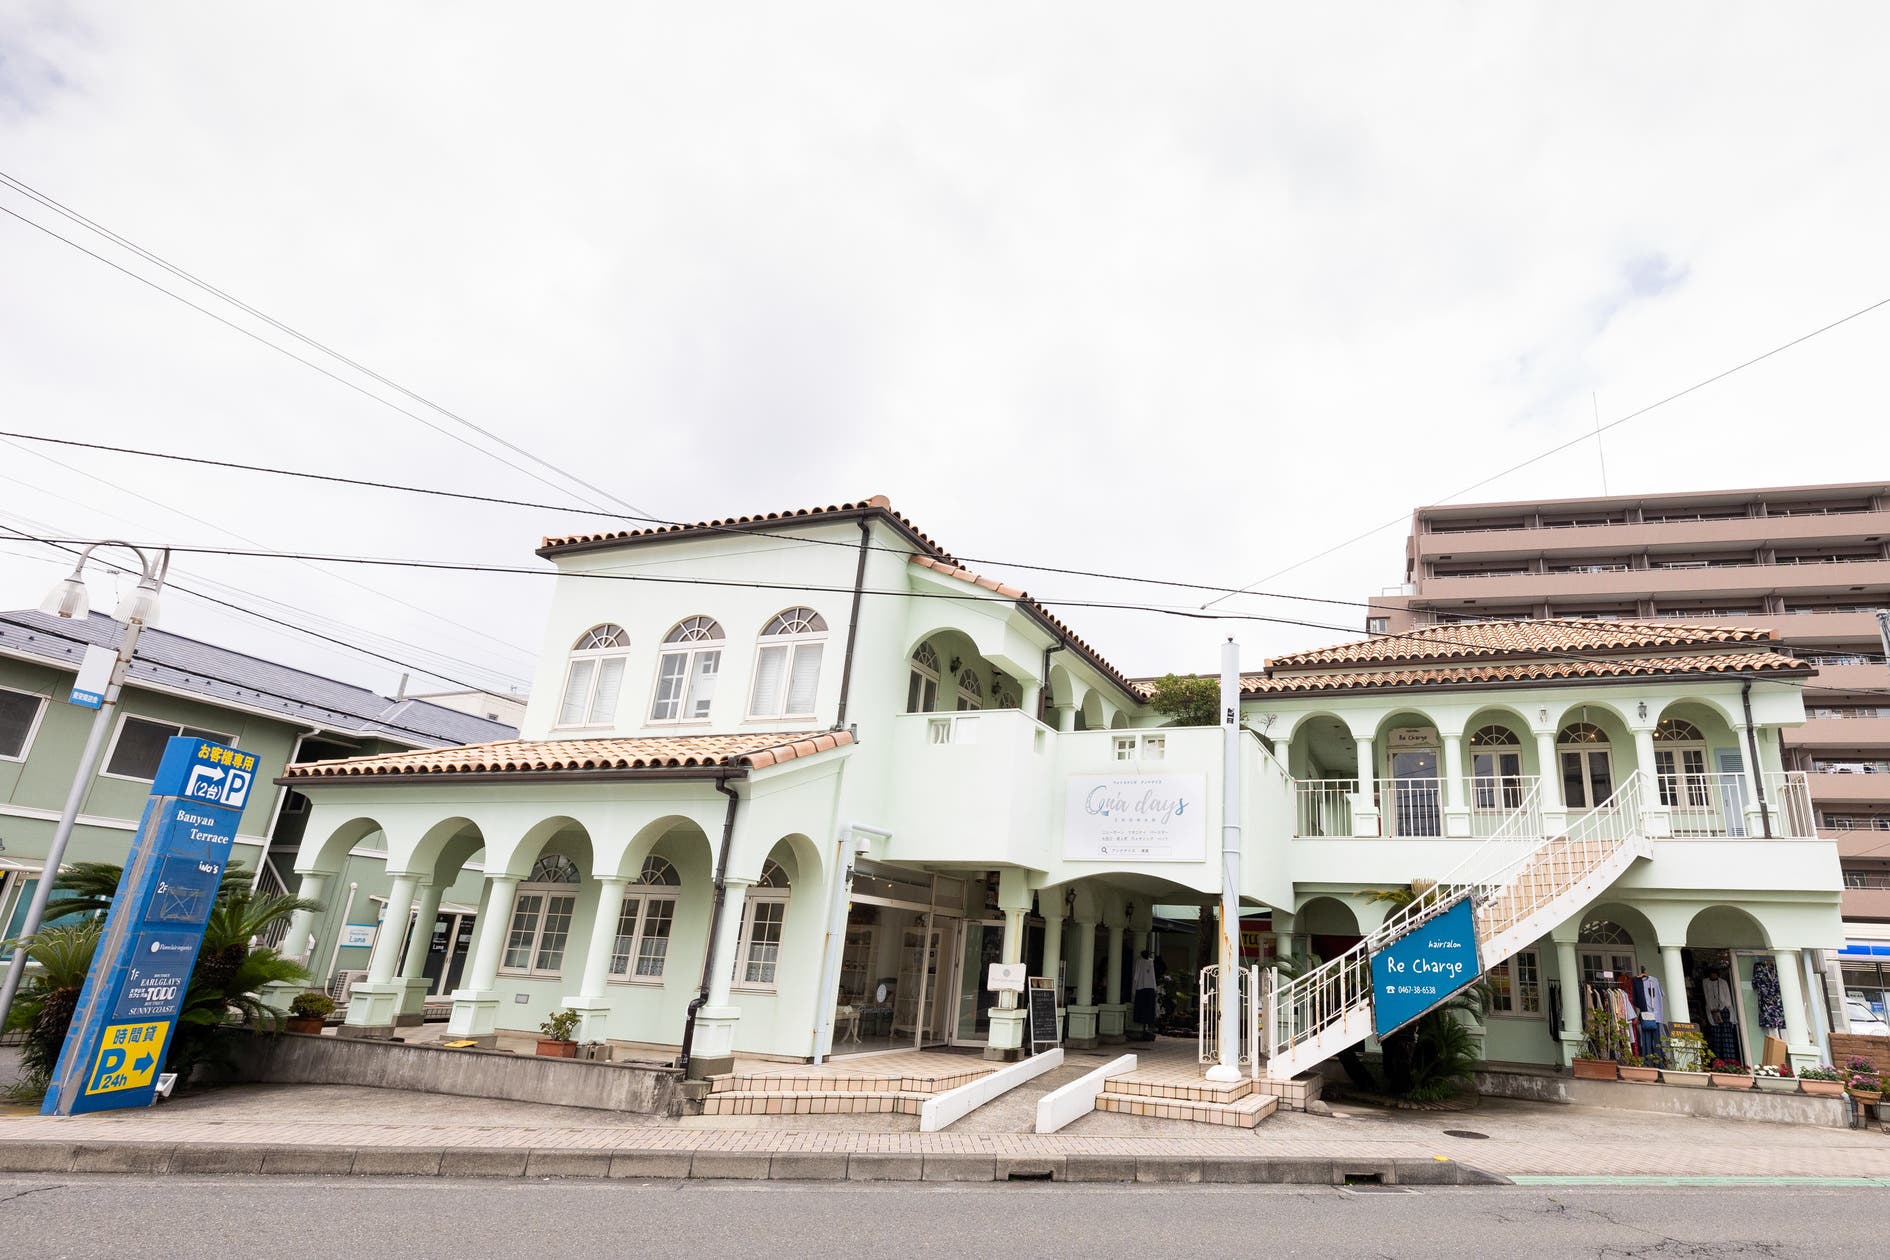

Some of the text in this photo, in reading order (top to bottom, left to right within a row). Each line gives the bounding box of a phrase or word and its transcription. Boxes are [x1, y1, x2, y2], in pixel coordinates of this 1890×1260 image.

[198, 744, 255, 772] お客様専用
[193, 773, 246, 801] (2台) P
[1135, 789, 1189, 824] days
[176, 810, 215, 826] Banyan
[190, 828, 229, 845] Terrace
[158, 881, 169, 894] 2F
[1428, 938, 1461, 949] hairsalon
[131, 968, 140, 981] 1F
[1387, 956, 1463, 979] Re Charge
[146, 986, 177, 1001] TODO
[1398, 985, 1436, 995] 0467-38-6538
[113, 1025, 157, 1044] 時間貸
[90, 1047, 127, 1091] P
[101, 1073, 127, 1090] 24h
